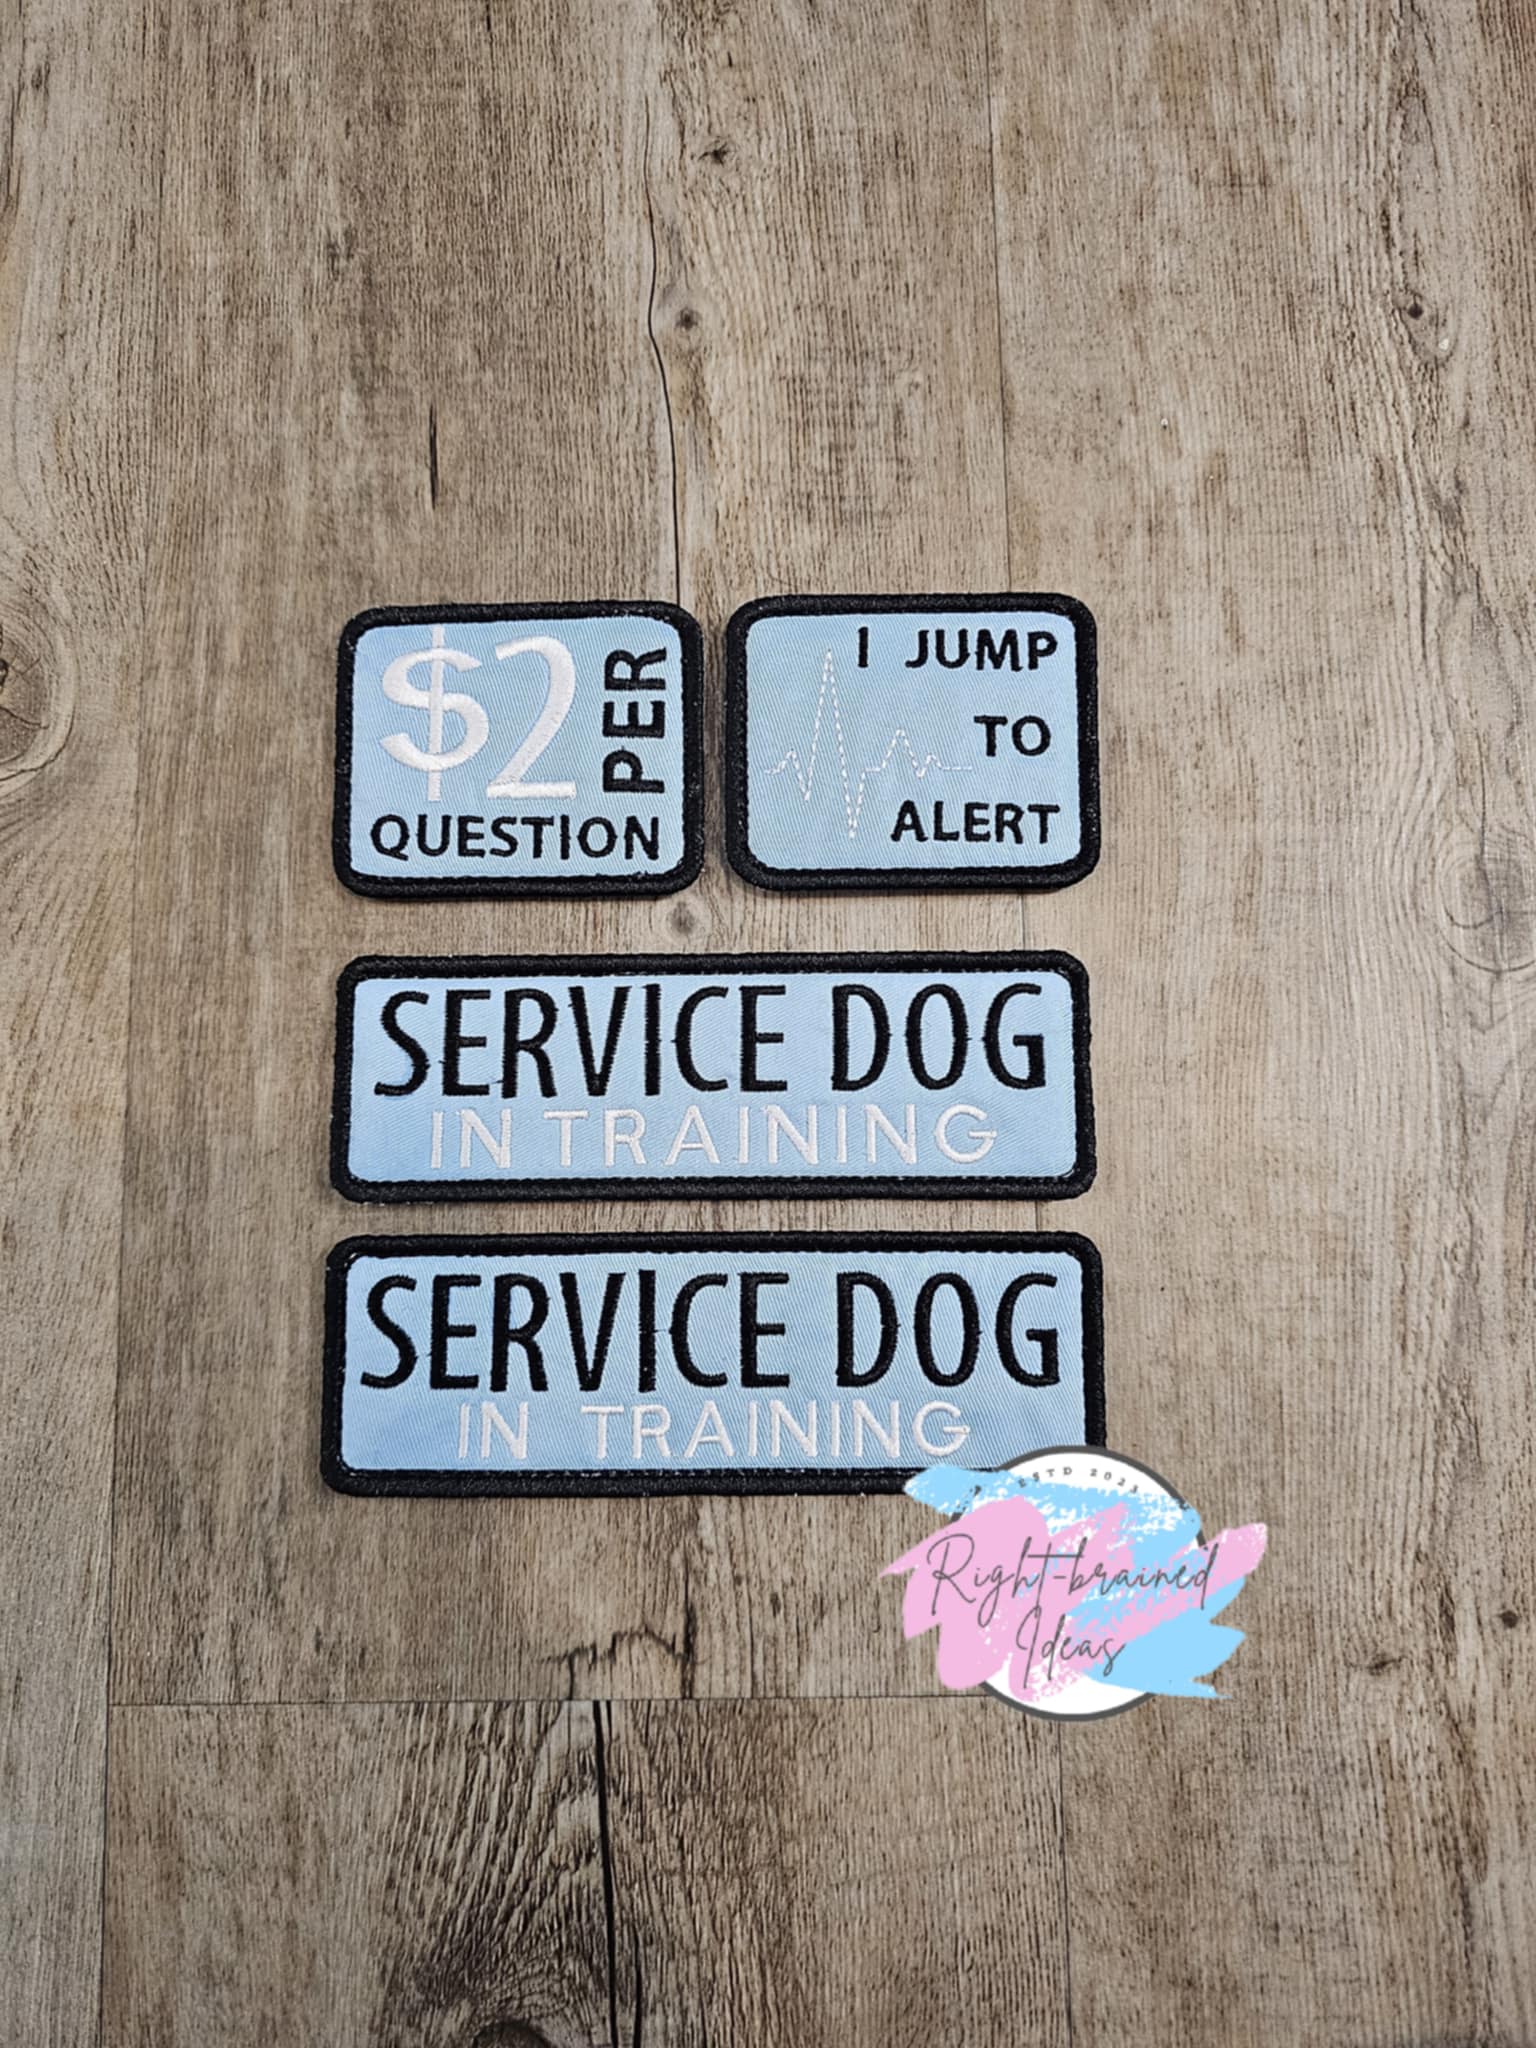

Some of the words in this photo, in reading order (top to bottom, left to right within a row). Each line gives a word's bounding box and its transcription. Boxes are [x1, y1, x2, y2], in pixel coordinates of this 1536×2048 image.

[857, 627, 870, 668] I
[905, 630, 1058, 672] JUMP
[380, 625, 577, 802] $2
[603, 647, 668, 793] PER
[974, 715, 1051, 757] TO
[370, 815, 660, 861] QUESTION
[891, 800, 1061, 843] ALERT
[374, 983, 788, 1098] SERVICE
[831, 983, 1046, 1092] DOG
[431, 1109, 512, 1169] IN
[544, 1104, 998, 1168] TRAINING
[361, 1270, 790, 1392] SERVICE
[836, 1272, 1060, 1388] DOG
[458, 1402, 528, 1460] IN
[581, 1401, 972, 1460] TRAINING
